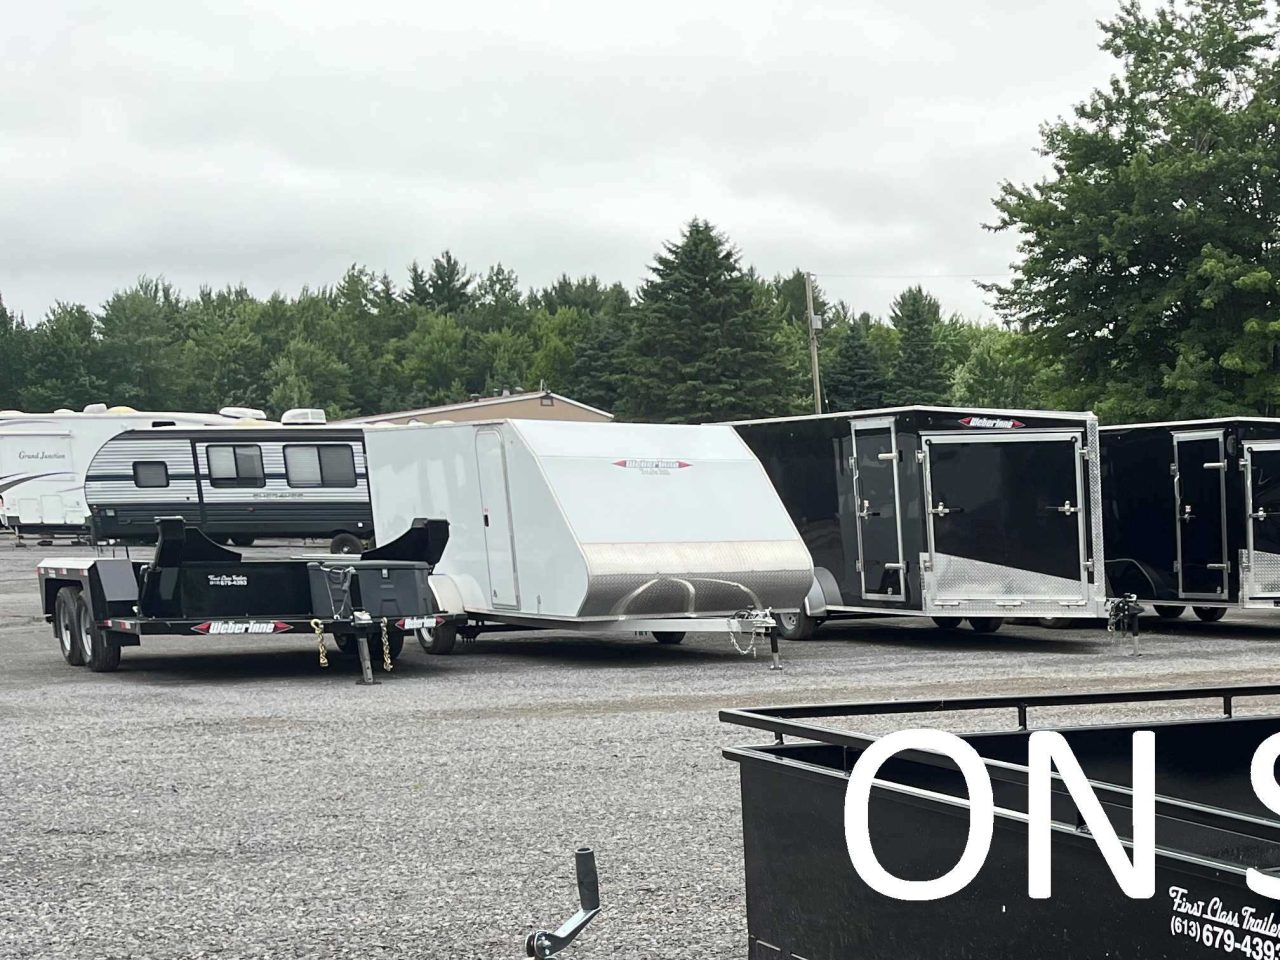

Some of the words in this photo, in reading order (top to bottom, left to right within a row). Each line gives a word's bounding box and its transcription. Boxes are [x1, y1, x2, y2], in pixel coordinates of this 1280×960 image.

[18, 450, 39, 460] Grand
[208, 620, 275, 634] Weberlane
[1169, 886, 1205, 917] First
[1202, 897, 1240, 928] Class
[1170, 915, 1201, 943] (613)
